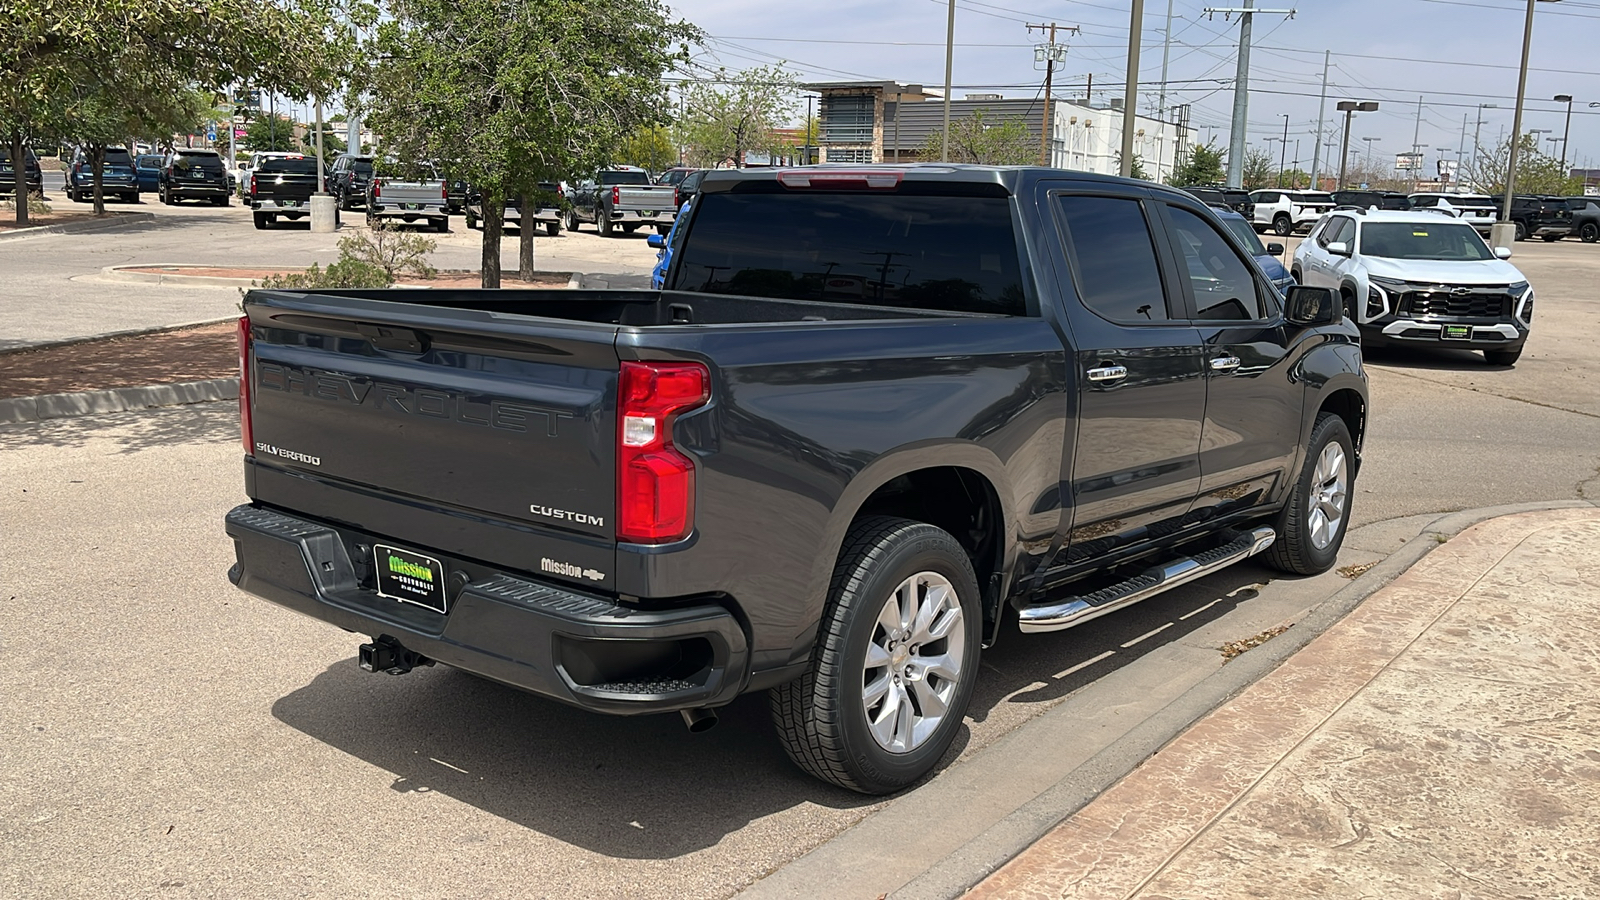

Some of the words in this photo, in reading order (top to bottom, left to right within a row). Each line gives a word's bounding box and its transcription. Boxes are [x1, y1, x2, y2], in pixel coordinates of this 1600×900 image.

[258, 362, 574, 437] CHEVROLET
[256, 442, 321, 466] SILVERADO
[530, 504, 604, 527] CUSTOM
[389, 555, 433, 582] Mission
[541, 557, 582, 578] Mission
